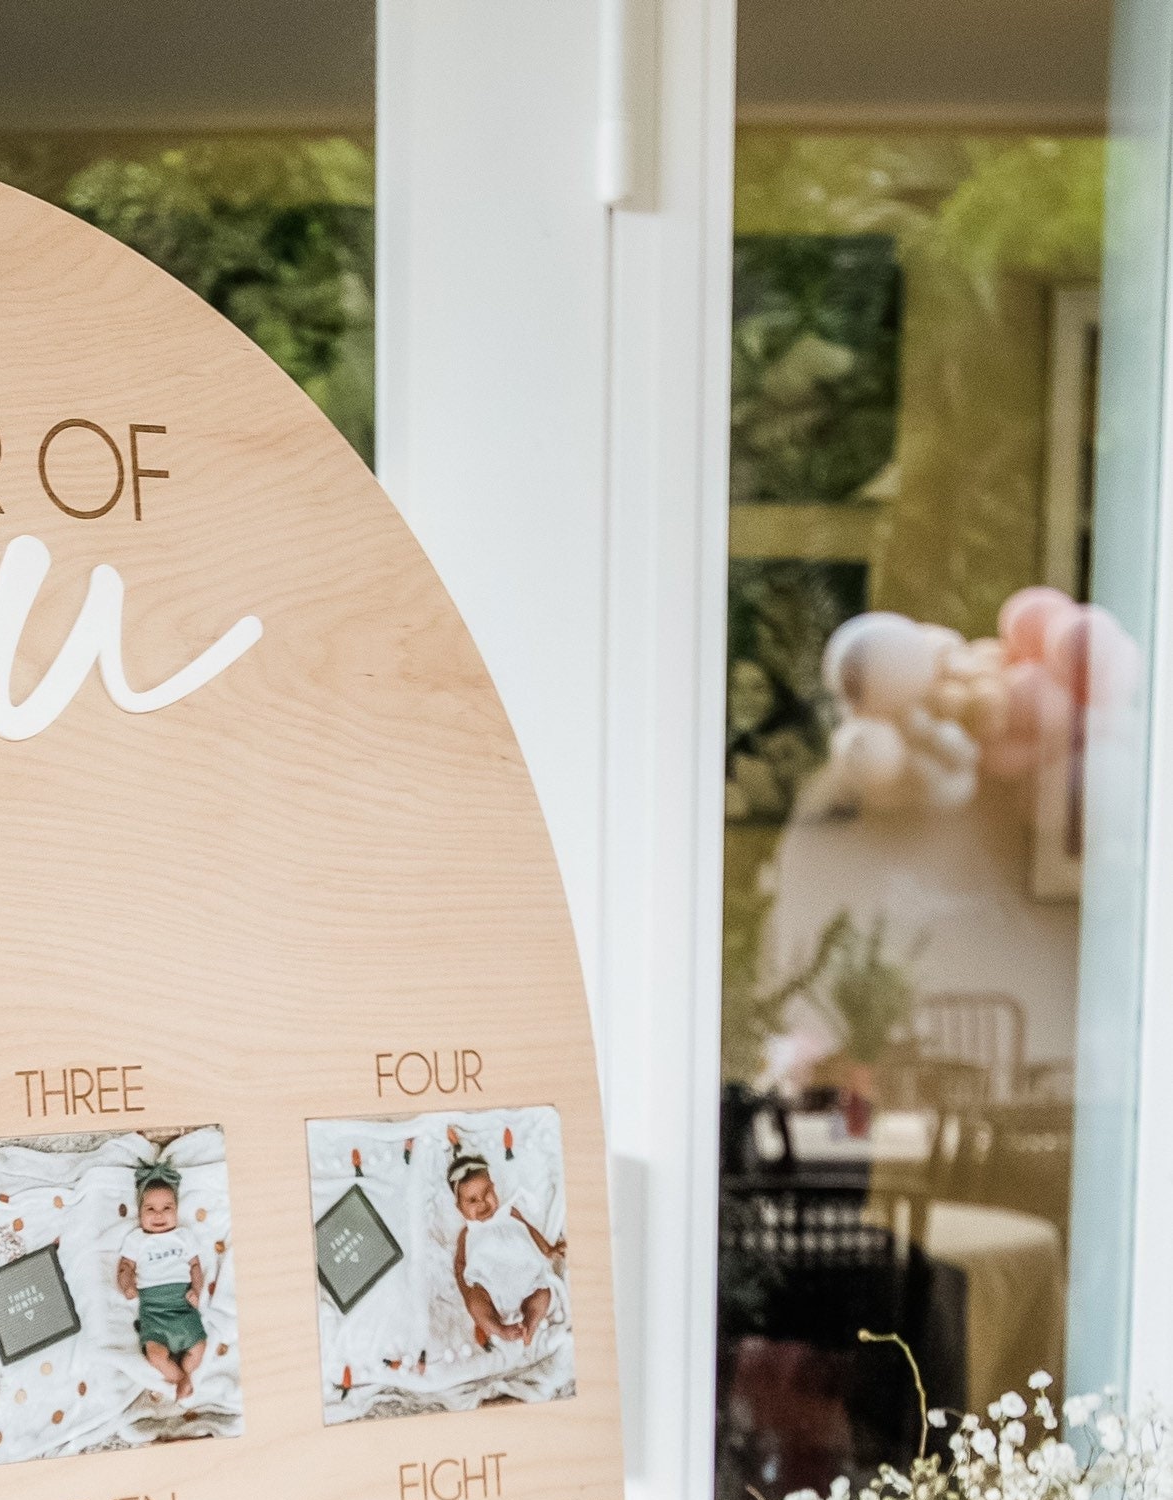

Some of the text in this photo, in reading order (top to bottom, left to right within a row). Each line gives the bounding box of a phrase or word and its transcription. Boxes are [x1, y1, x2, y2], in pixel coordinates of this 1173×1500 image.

[38, 419, 169, 521] OF
[15, 1066, 145, 1117] THREE
[376, 1050, 482, 1097] FOUR
